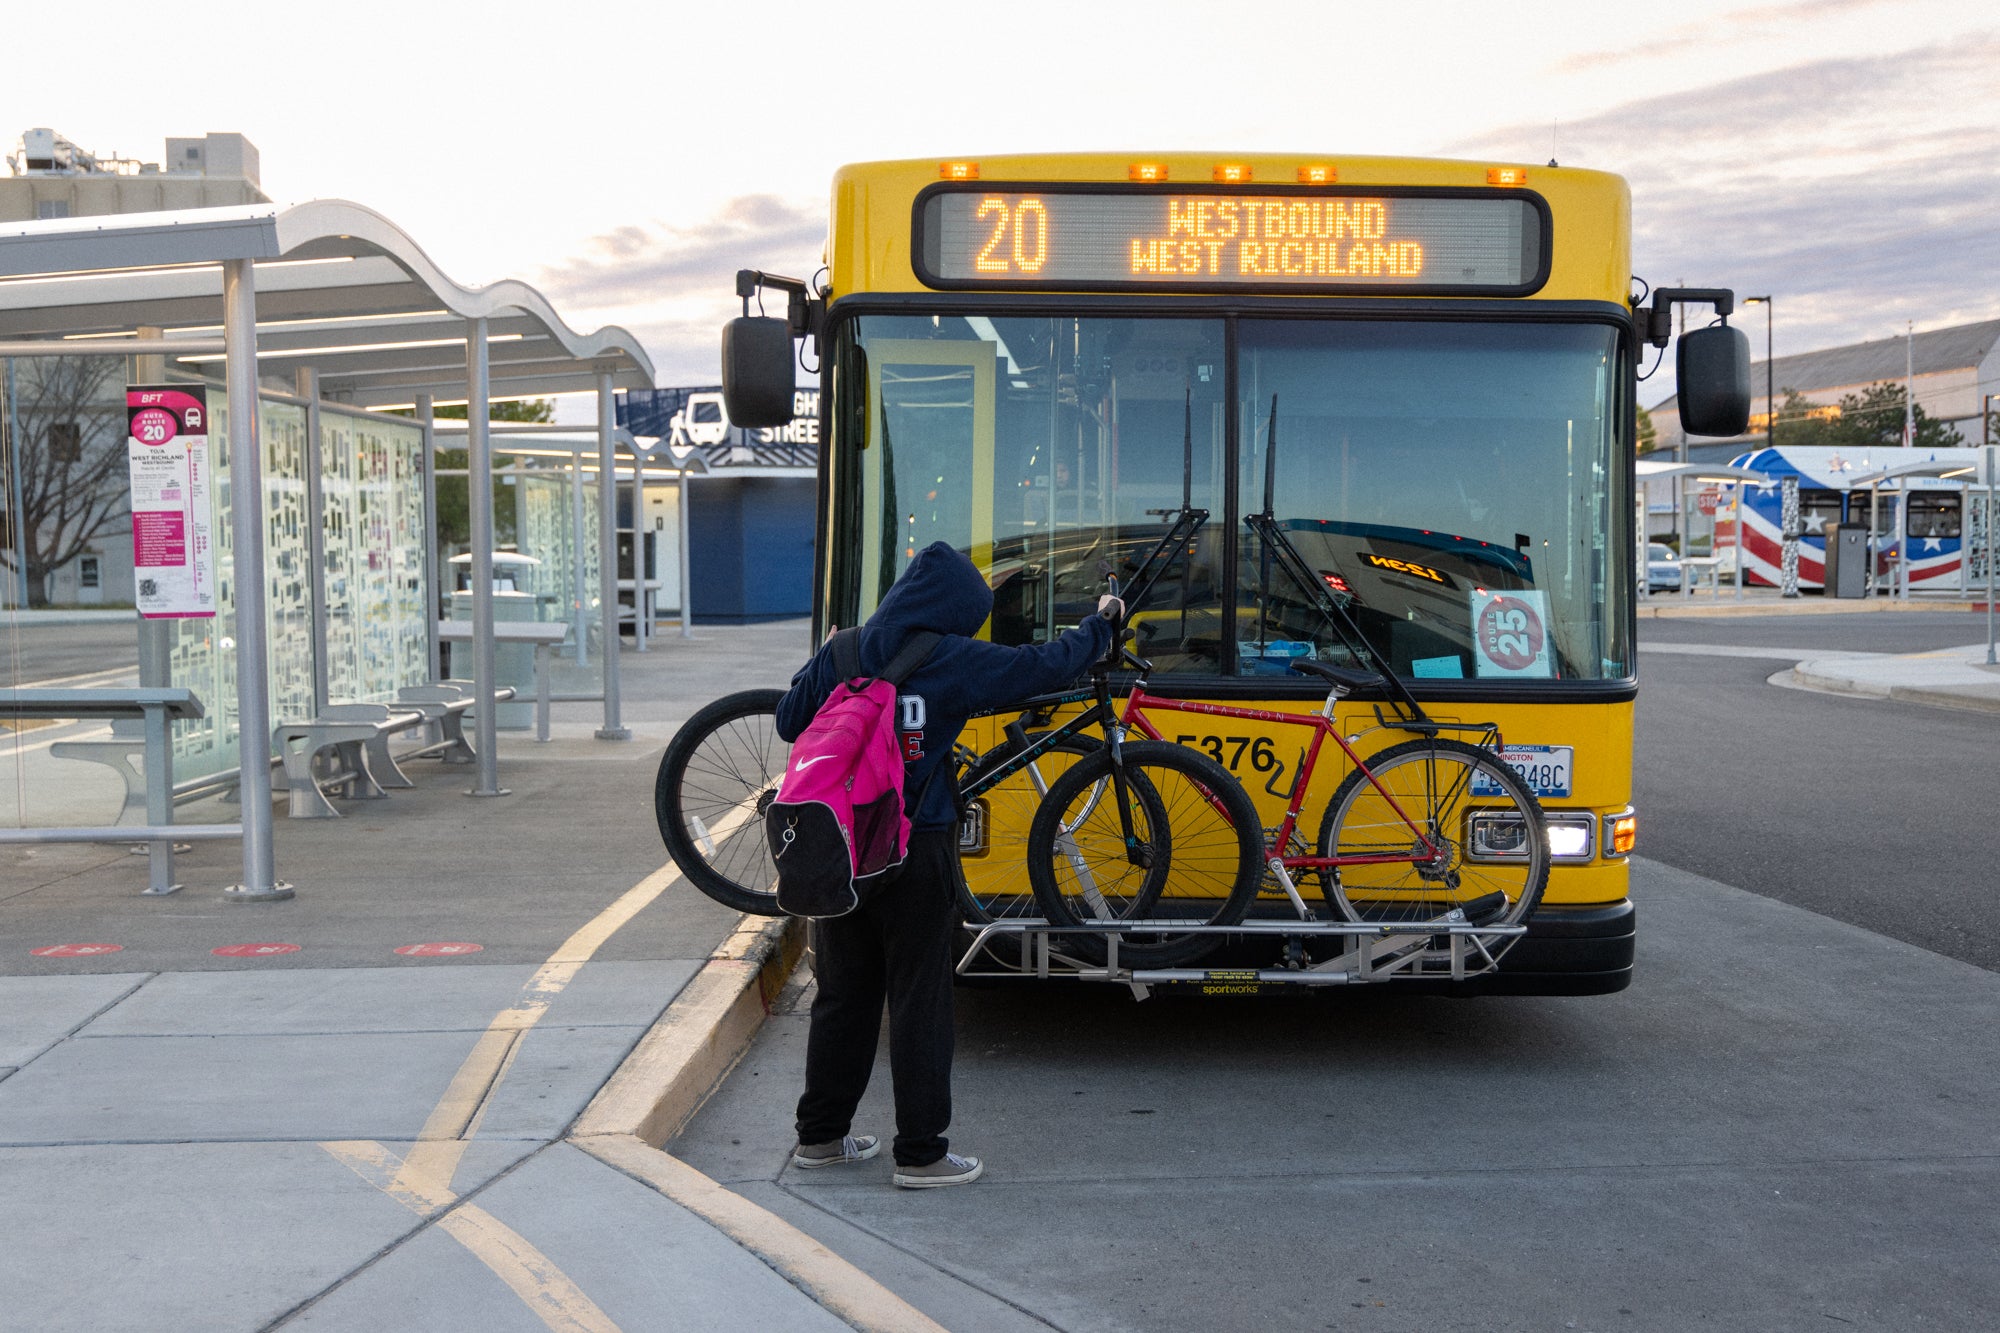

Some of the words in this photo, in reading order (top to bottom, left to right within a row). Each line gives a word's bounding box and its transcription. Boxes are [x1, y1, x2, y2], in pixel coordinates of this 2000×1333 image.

[1169, 200, 1385, 239] WESTBOUND
[976, 198, 1047, 272] 20
[1131, 240, 1225, 273] WEST
[1240, 241, 1423, 275] RICHLAND
[141, 393, 163, 403] BFT
[794, 391, 820, 416] GH
[143, 425, 165, 441] 20
[1699, 495, 1718, 508] STO
[1486, 612, 1498, 652] ROUTE
[1495, 608, 1530, 657] 25
[1203, 985, 1258, 995] sportworks
